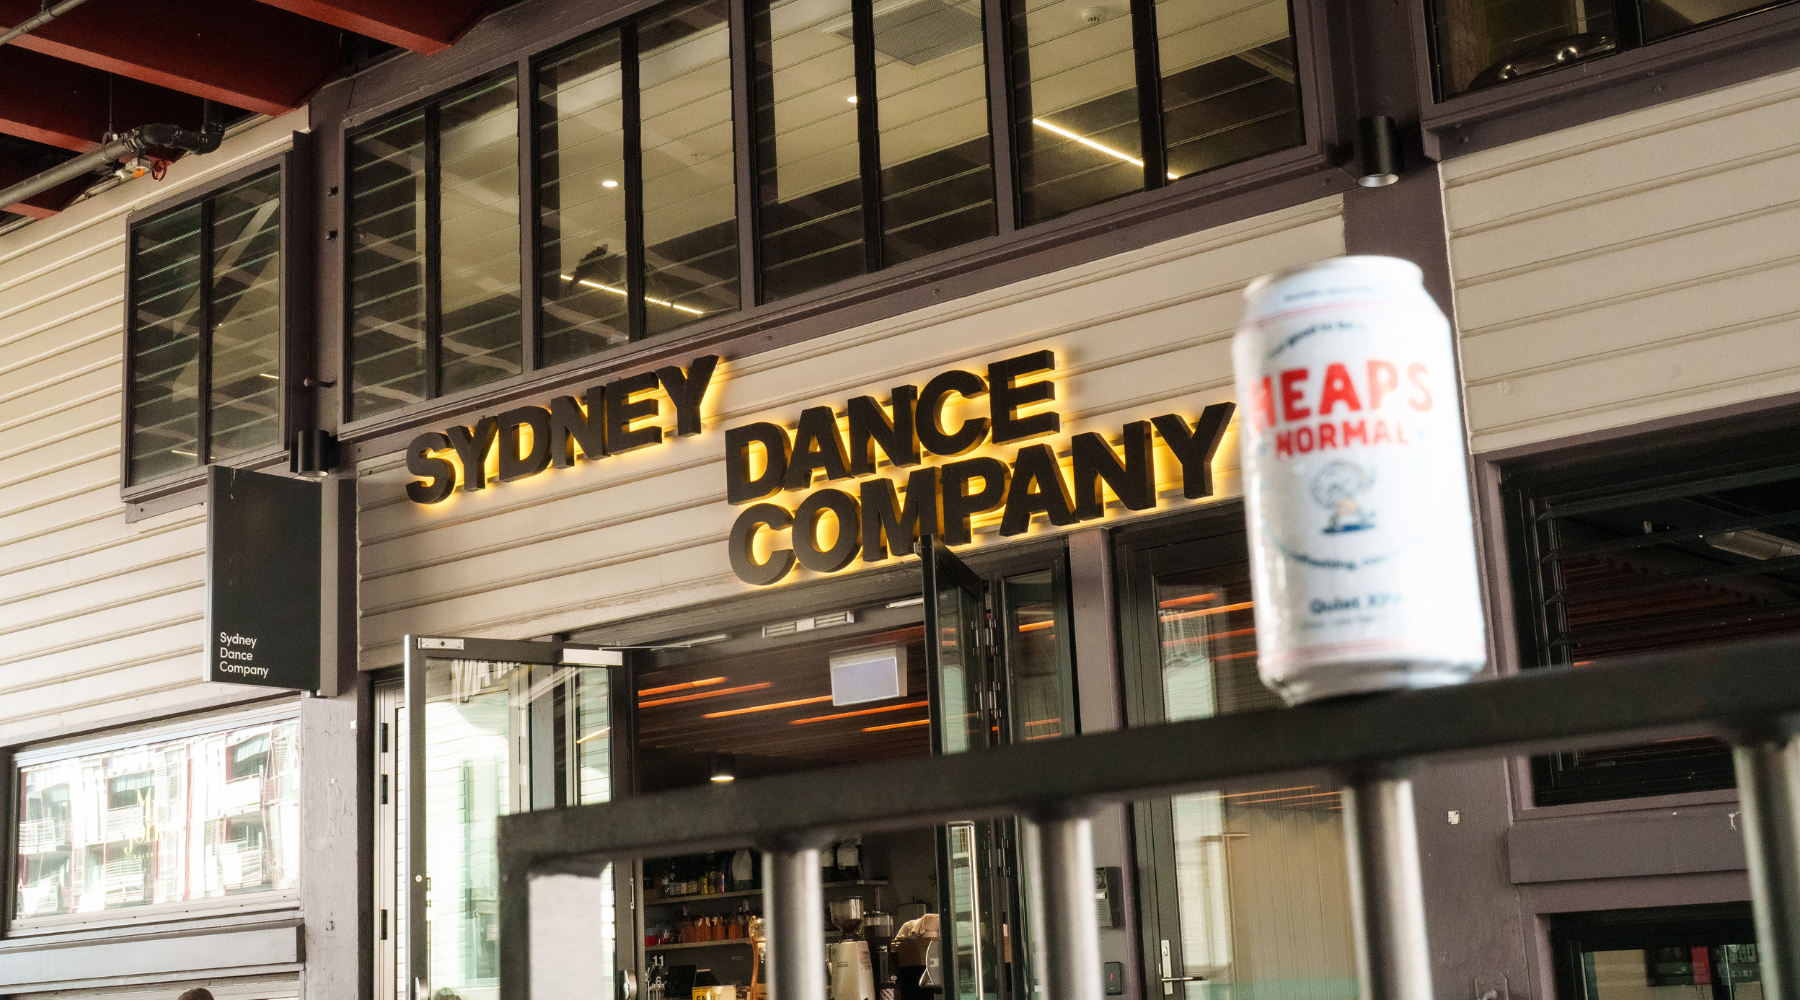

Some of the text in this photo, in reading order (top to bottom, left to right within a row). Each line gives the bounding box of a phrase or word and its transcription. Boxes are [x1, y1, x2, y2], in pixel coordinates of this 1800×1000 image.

[1249, 359, 1433, 436] HEAPS
[405, 354, 719, 505] SYDNEY
[725, 349, 1060, 506] DANCE
[1275, 419, 1409, 460] NORMAL
[728, 401, 1237, 586] COMPANY
[220, 631, 258, 649] Sydney
[220, 647, 253, 661] Dance
[220, 661, 269, 679] Company
